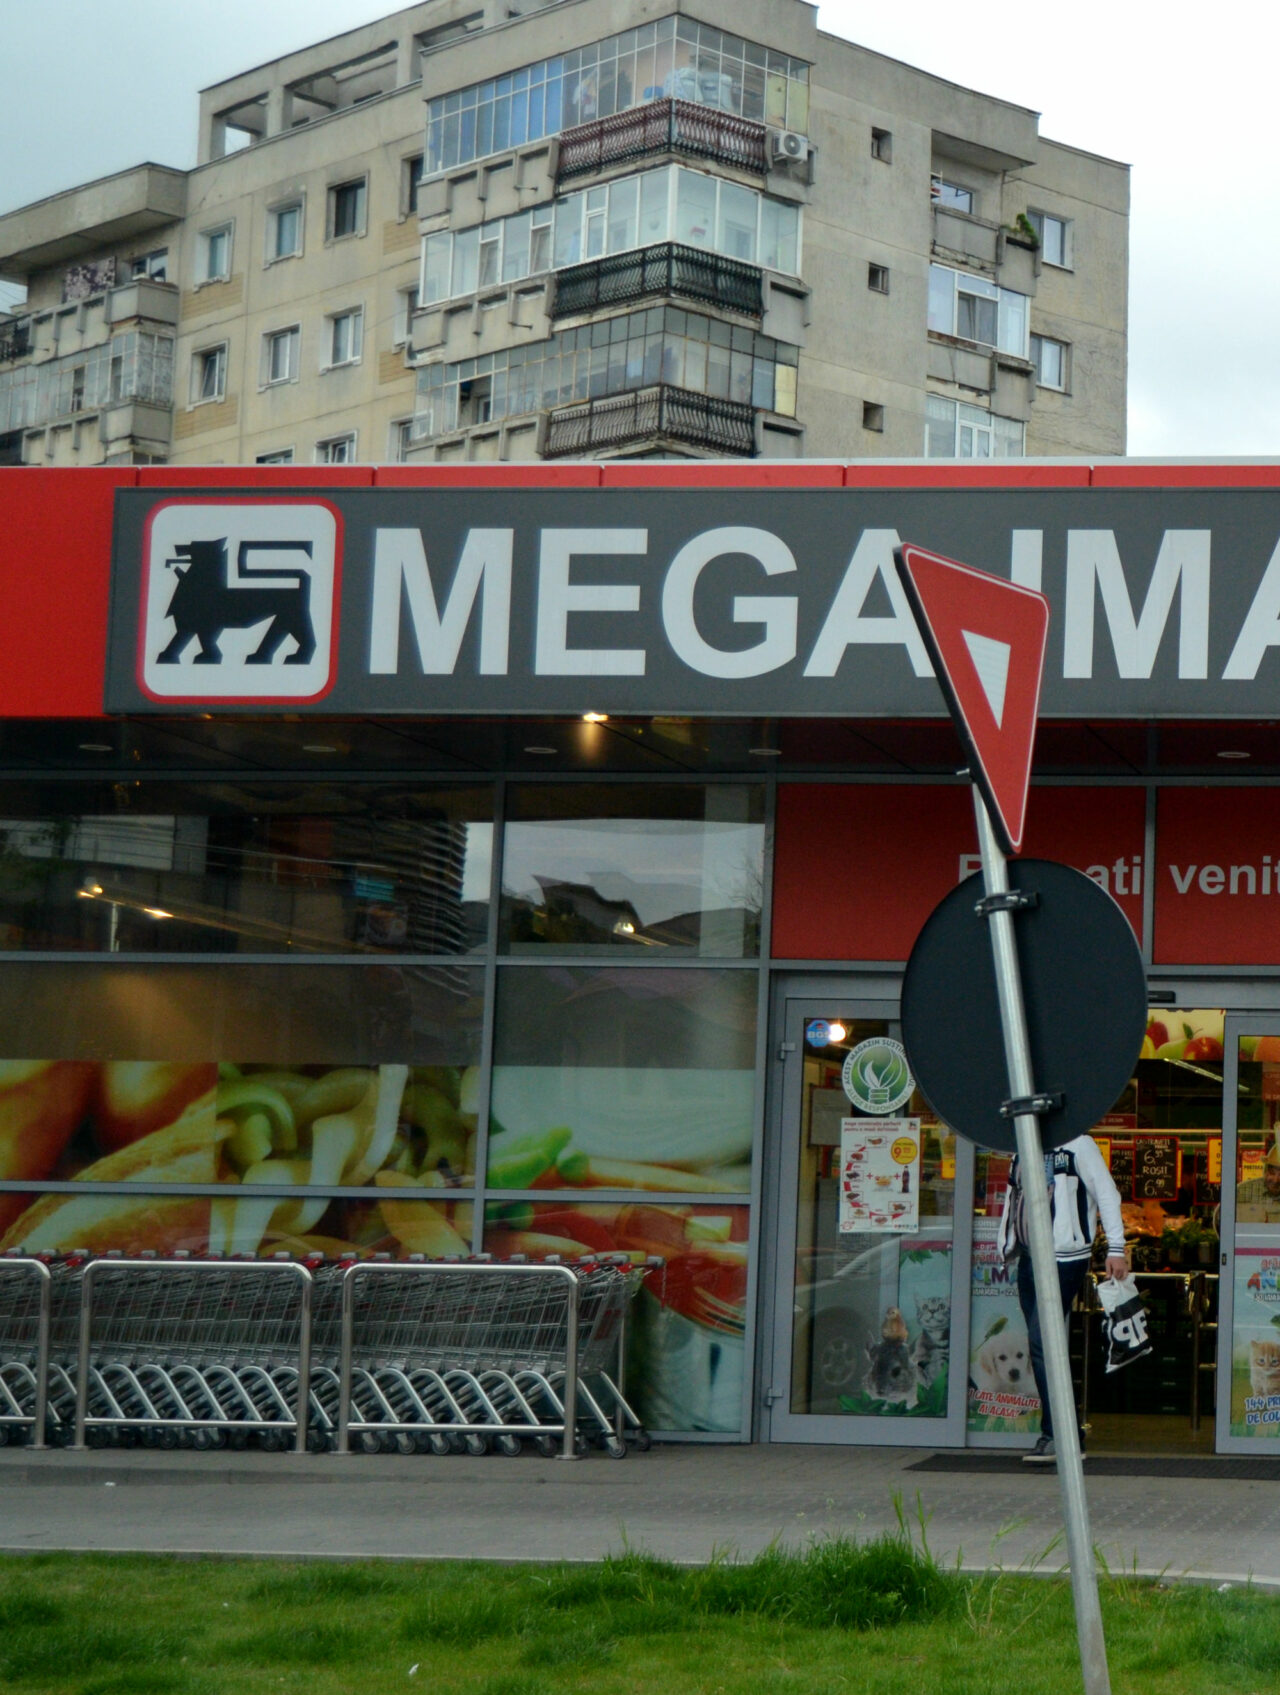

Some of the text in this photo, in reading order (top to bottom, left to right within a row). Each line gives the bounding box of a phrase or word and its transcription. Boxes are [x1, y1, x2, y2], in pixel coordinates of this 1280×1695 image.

[369, 526, 937, 679] MEGA
[850, 1039, 880, 1060] MAGAZIN
[1245, 1397, 1265, 1410] 144
[1247, 1413, 1260, 1424] DE
